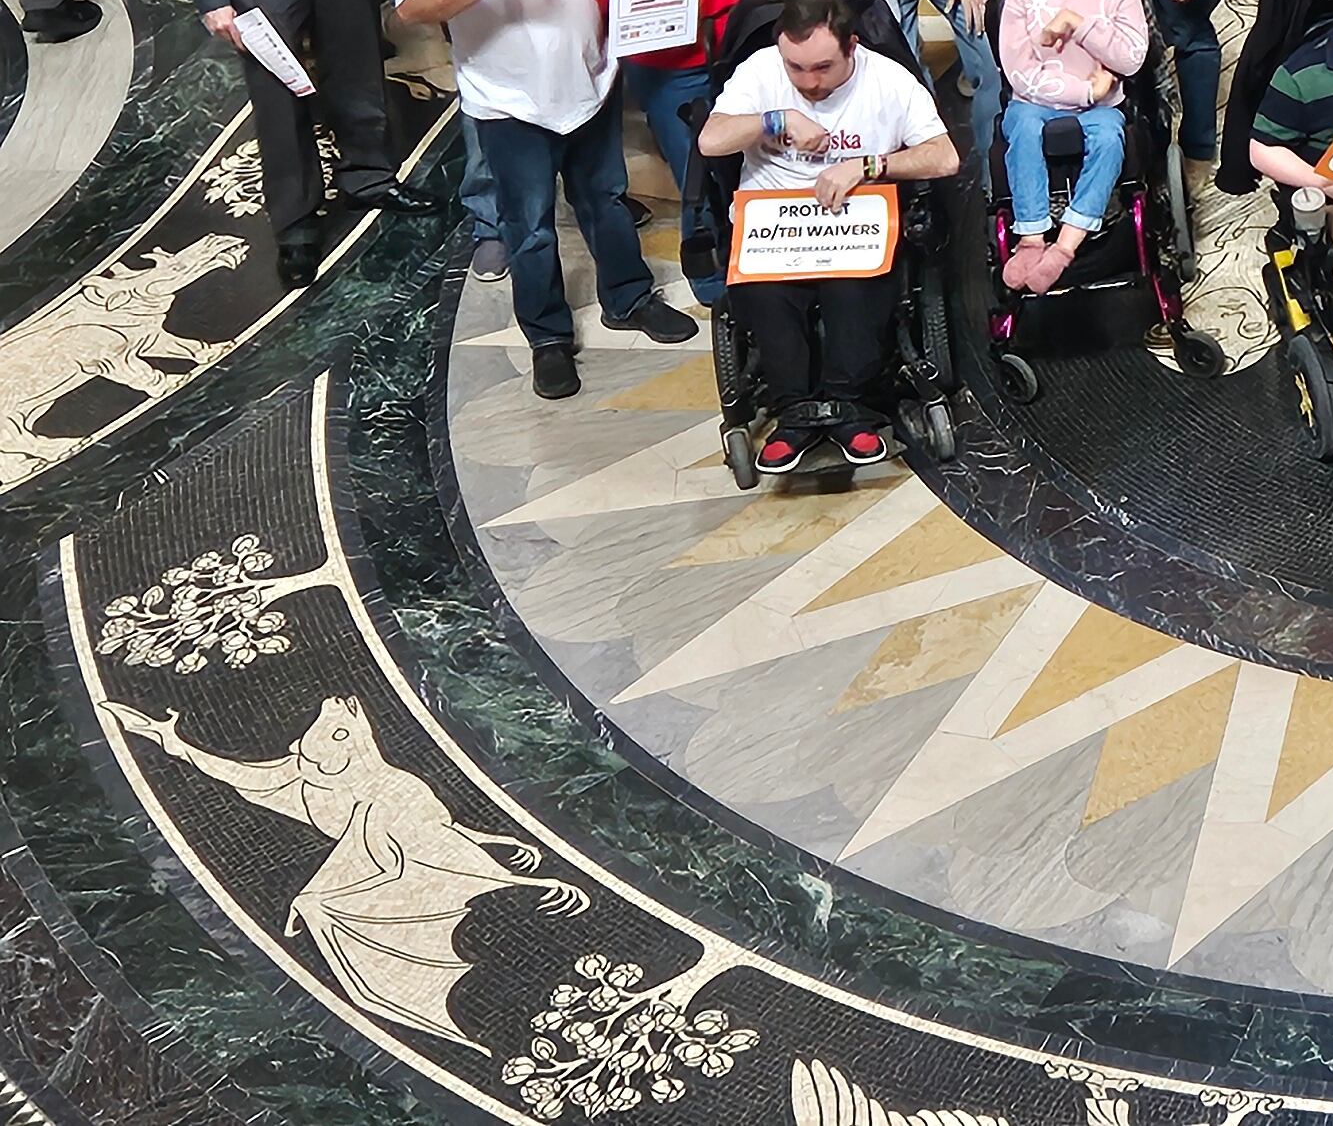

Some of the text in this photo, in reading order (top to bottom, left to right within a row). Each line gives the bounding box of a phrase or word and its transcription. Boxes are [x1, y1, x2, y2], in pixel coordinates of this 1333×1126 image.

[779, 203, 850, 217] PROTET
[748, 224, 880, 241] AD/TBI WAIVERS
